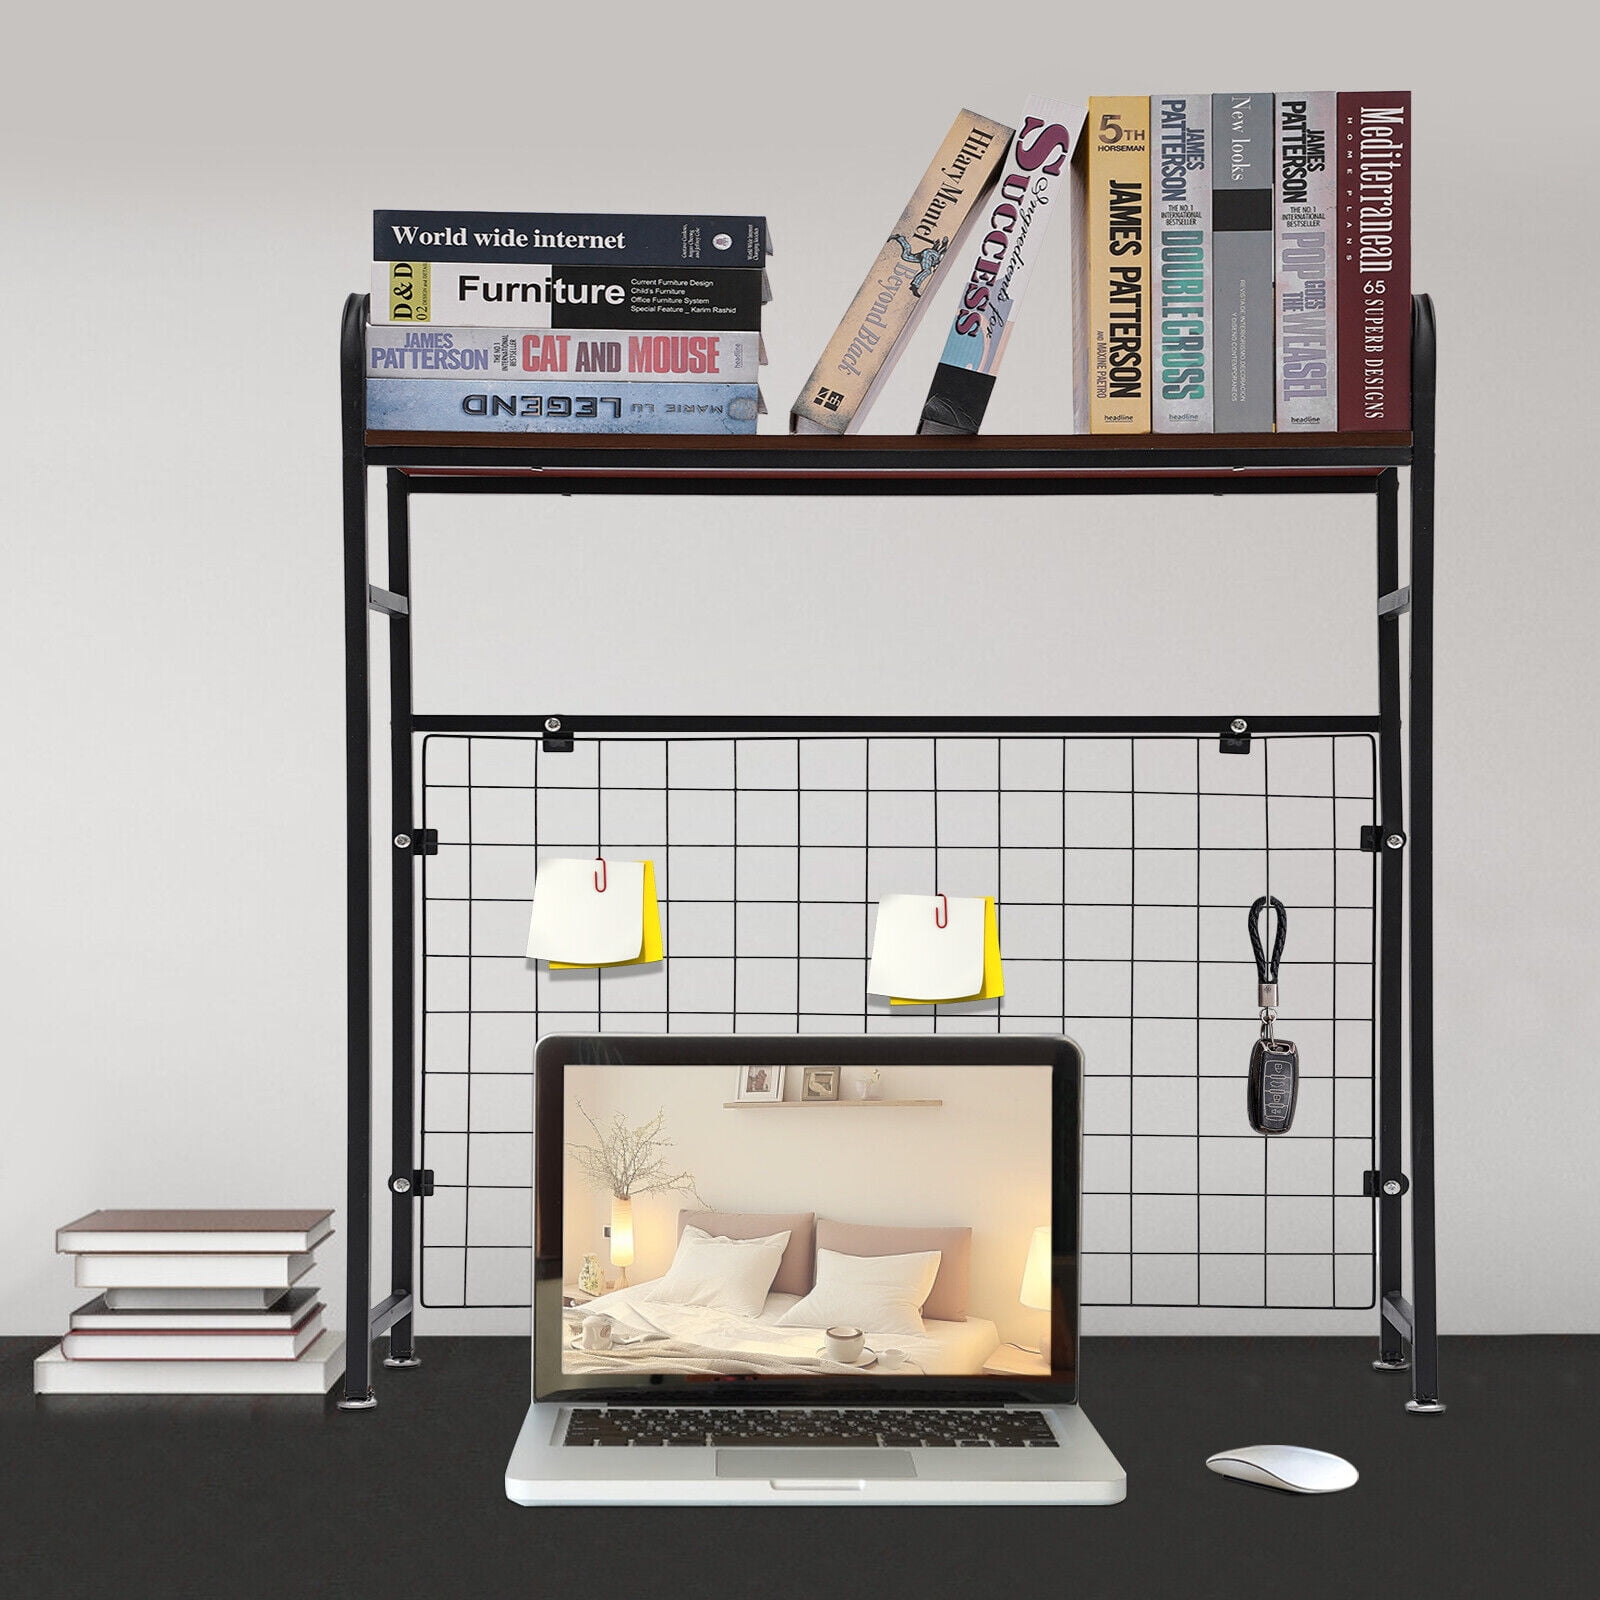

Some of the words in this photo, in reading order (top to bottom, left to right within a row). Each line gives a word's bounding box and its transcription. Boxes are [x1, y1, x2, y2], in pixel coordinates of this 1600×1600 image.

[1099, 114, 1146, 144] 5TH
[1231, 95, 1253, 135] New
[941, 127, 995, 185] Hilary
[1161, 99, 1187, 202] PATTERSON
[1186, 127, 1205, 171] JAMES
[1231, 138, 1253, 181] looks
[1281, 100, 1308, 204] PATTERSON
[1307, 129, 1325, 173] JAMES
[1359, 106, 1405, 273] Mediterranean
[912, 183, 964, 245] Mantel
[1109, 179, 1143, 256] JAMES
[1166, 218, 1197, 226] BESTSELLER
[1290, 206, 1301, 214] THE
[391, 225, 467, 247] World
[472, 227, 529, 248] wide
[534, 228, 626, 250] internet
[996, 176, 1050, 301] Ingredients
[1281, 231, 1326, 280] POP
[457, 274, 625, 306] Furniture
[630, 278, 657, 286] Current
[658, 278, 688, 287] Furniture
[689, 279, 714, 288] Design
[655, 287, 686, 295] Furniture
[865, 262, 918, 329] Beyond
[1304, 280, 1326, 310] GOES
[1363, 280, 1386, 294] 65
[416, 306, 428, 321] 02
[630, 296, 651, 304] Office
[683, 297, 710, 306] System
[630, 305, 656, 314] Special
[657, 305, 684, 313] Feature
[690, 306, 711, 314] Karim
[712, 306, 737, 314] Rashid
[1282, 291, 1304, 312] THE
[984, 302, 1004, 339] for
[1109, 266, 1143, 399] PATTERSON
[1364, 299, 1385, 353] SUPERB
[404, 332, 454, 349] JAMES
[501, 334, 509, 372] INTERNATIONAL
[509, 339, 517, 367] BESTSELLER
[522, 334, 571, 372] CAT
[575, 341, 622, 373] AND
[628, 336, 720, 374] MOUSE
[838, 325, 881, 377] Black
[371, 347, 489, 370] PATTERSON
[1097, 342, 1107, 370] MAXINE
[1282, 311, 1328, 402] WEASEL
[1097, 371, 1107, 399] PAETRO
[1364, 359, 1385, 419] DESIGNS
[463, 394, 622, 418] LEGEND
[630, 402, 655, 413] LU
[666, 403, 724, 415] MARIE
[1104, 414, 1134, 422] headline
[1168, 413, 1199, 421] headline
[1290, 416, 1321, 424] headline
